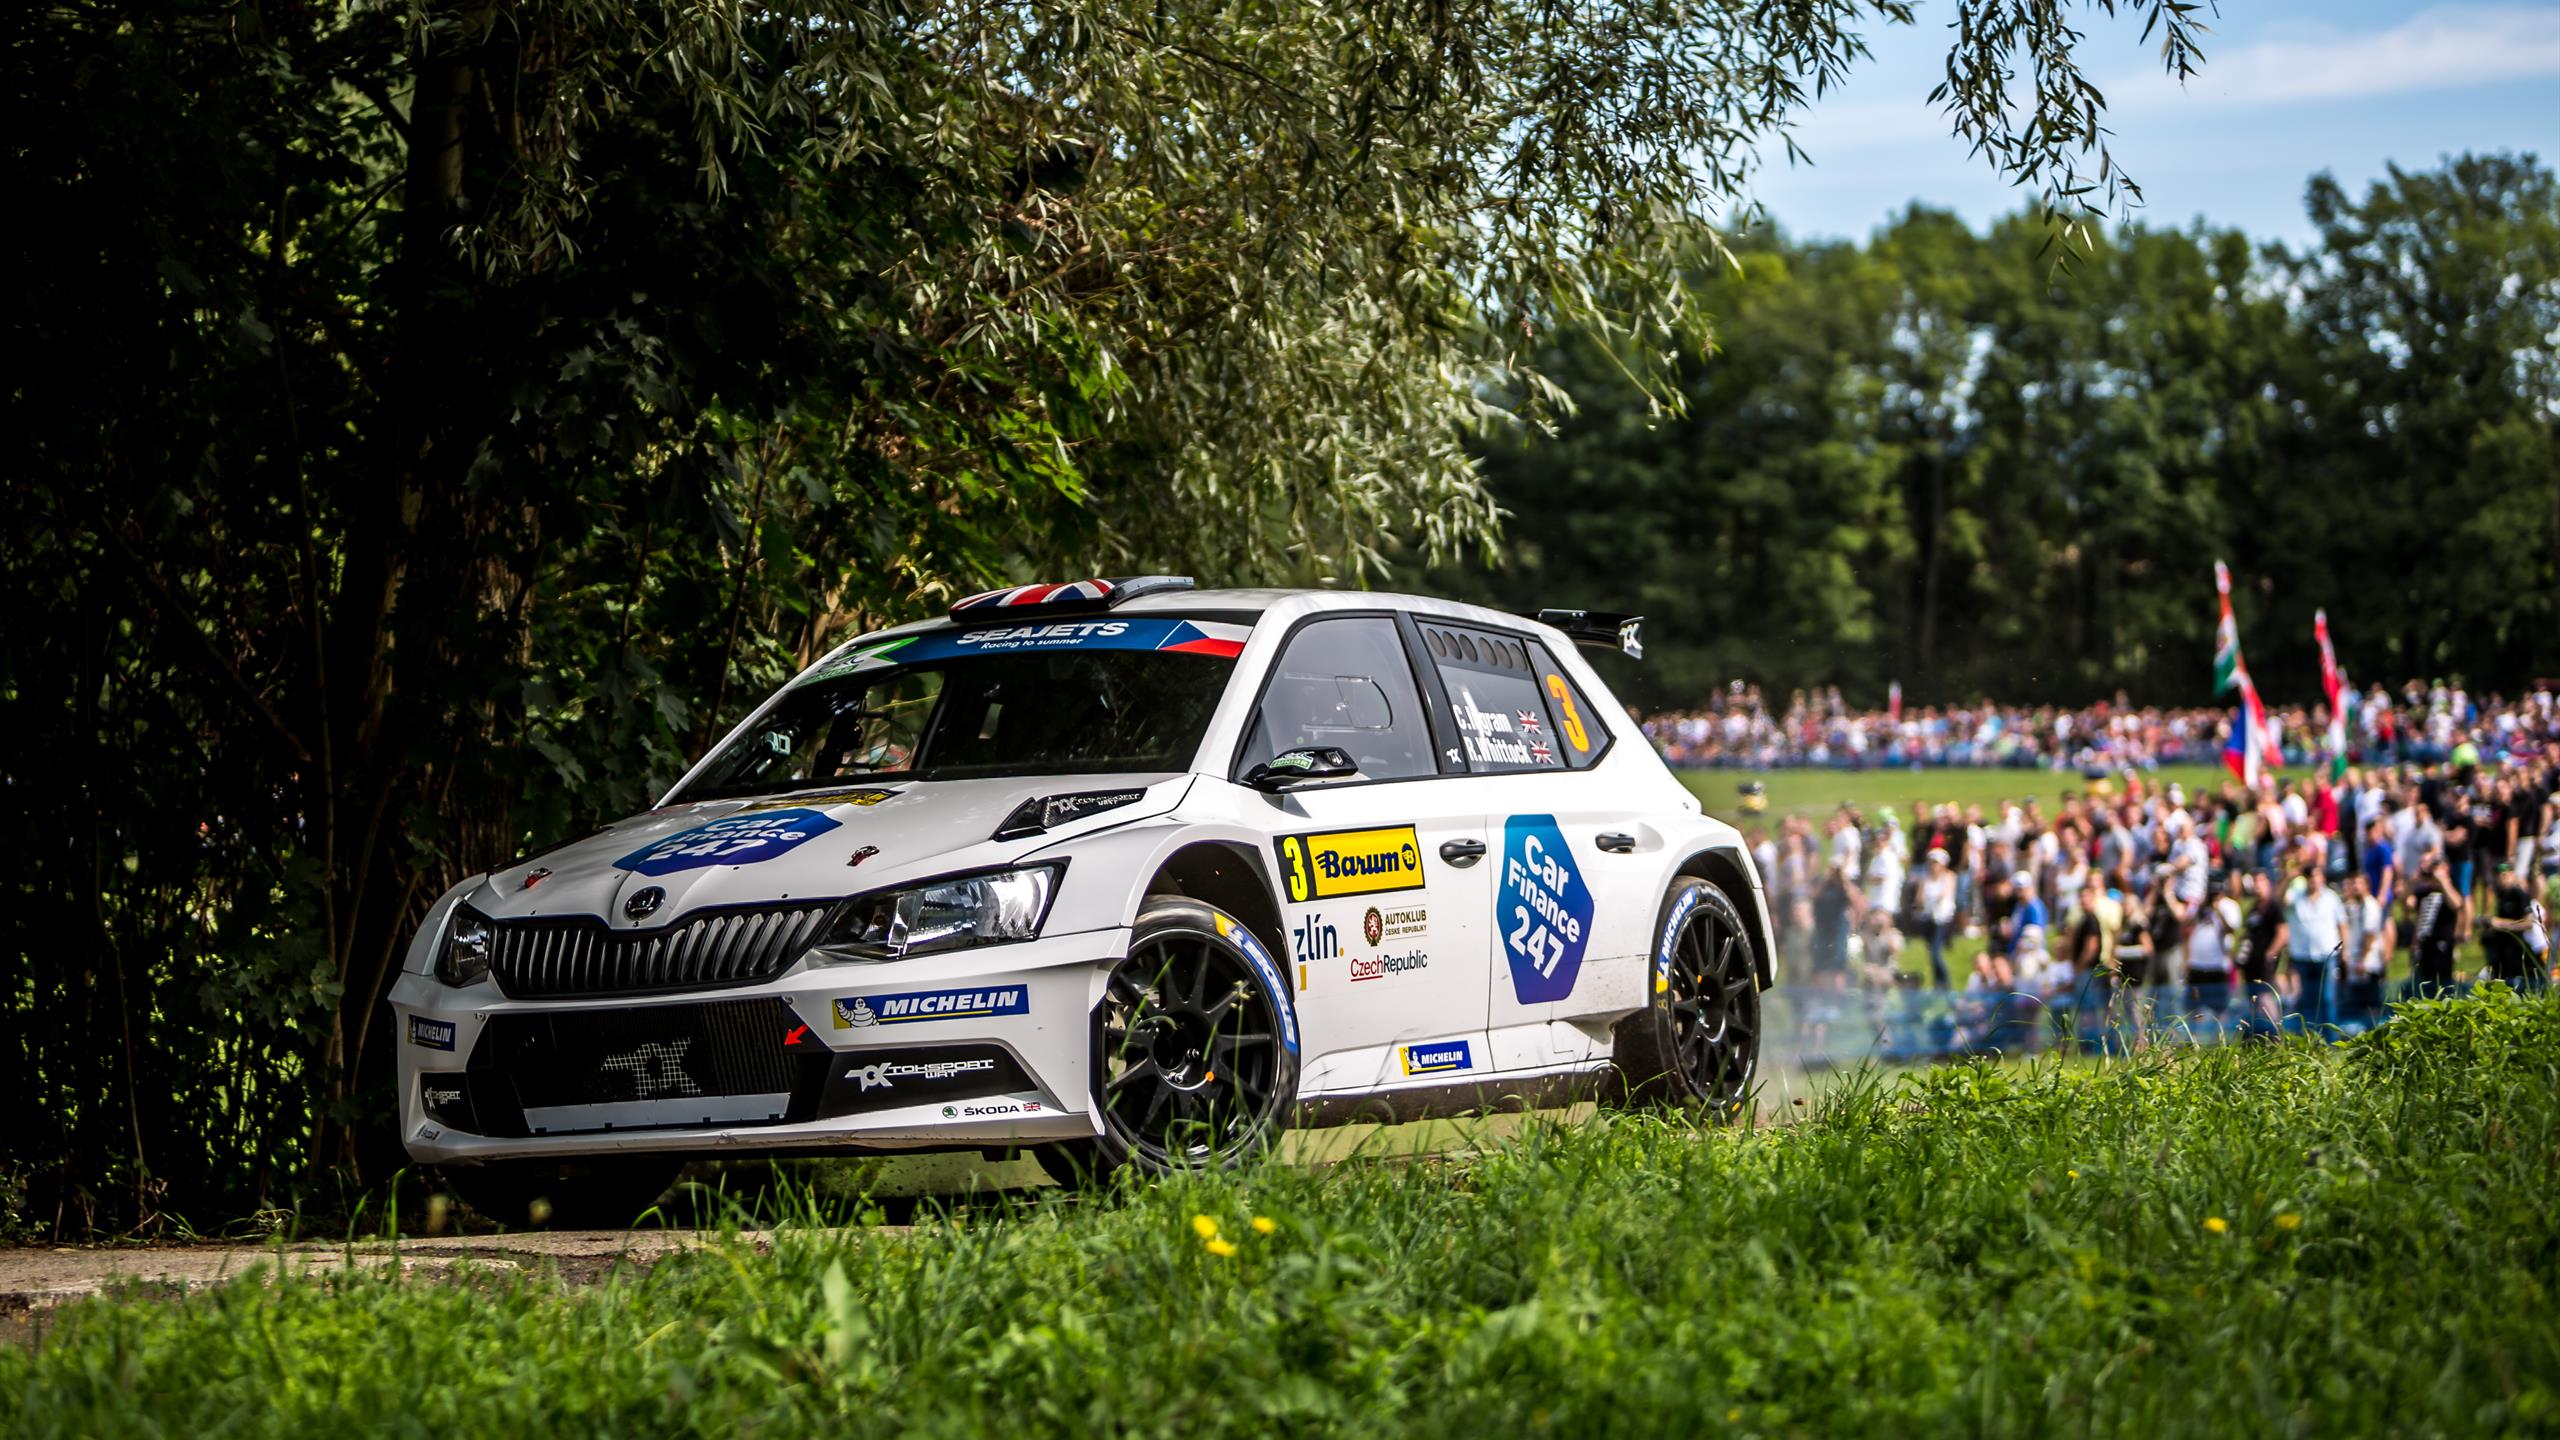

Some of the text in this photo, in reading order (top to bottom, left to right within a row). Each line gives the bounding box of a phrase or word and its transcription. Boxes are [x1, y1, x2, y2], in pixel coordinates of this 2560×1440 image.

[957, 622, 1130, 645] SEAJETS
[980, 641, 1020, 649] Racing
[1037, 637, 1084, 646] summer
[1546, 673, 1591, 753] 3
[1463, 736, 1534, 764] R.Whittock
[677, 828, 807, 842] inance
[704, 817, 800, 832] Car
[643, 838, 769, 862] 247
[1283, 836, 1400, 902] 3 Barum
[1525, 834, 1569, 898] Car
[1508, 856, 1580, 943] Finance
[1385, 909, 1427, 926] AUTOKLUB
[1661, 891, 1694, 959] MICHELIN
[1509, 905, 1565, 979] 247
[882, 990, 1019, 1016] MICHELIN
[417, 1023, 452, 1043] MICHELIN
[1421, 1050, 1463, 1065] MICHELIN
[964, 1105, 1020, 1117] ŠKODA
